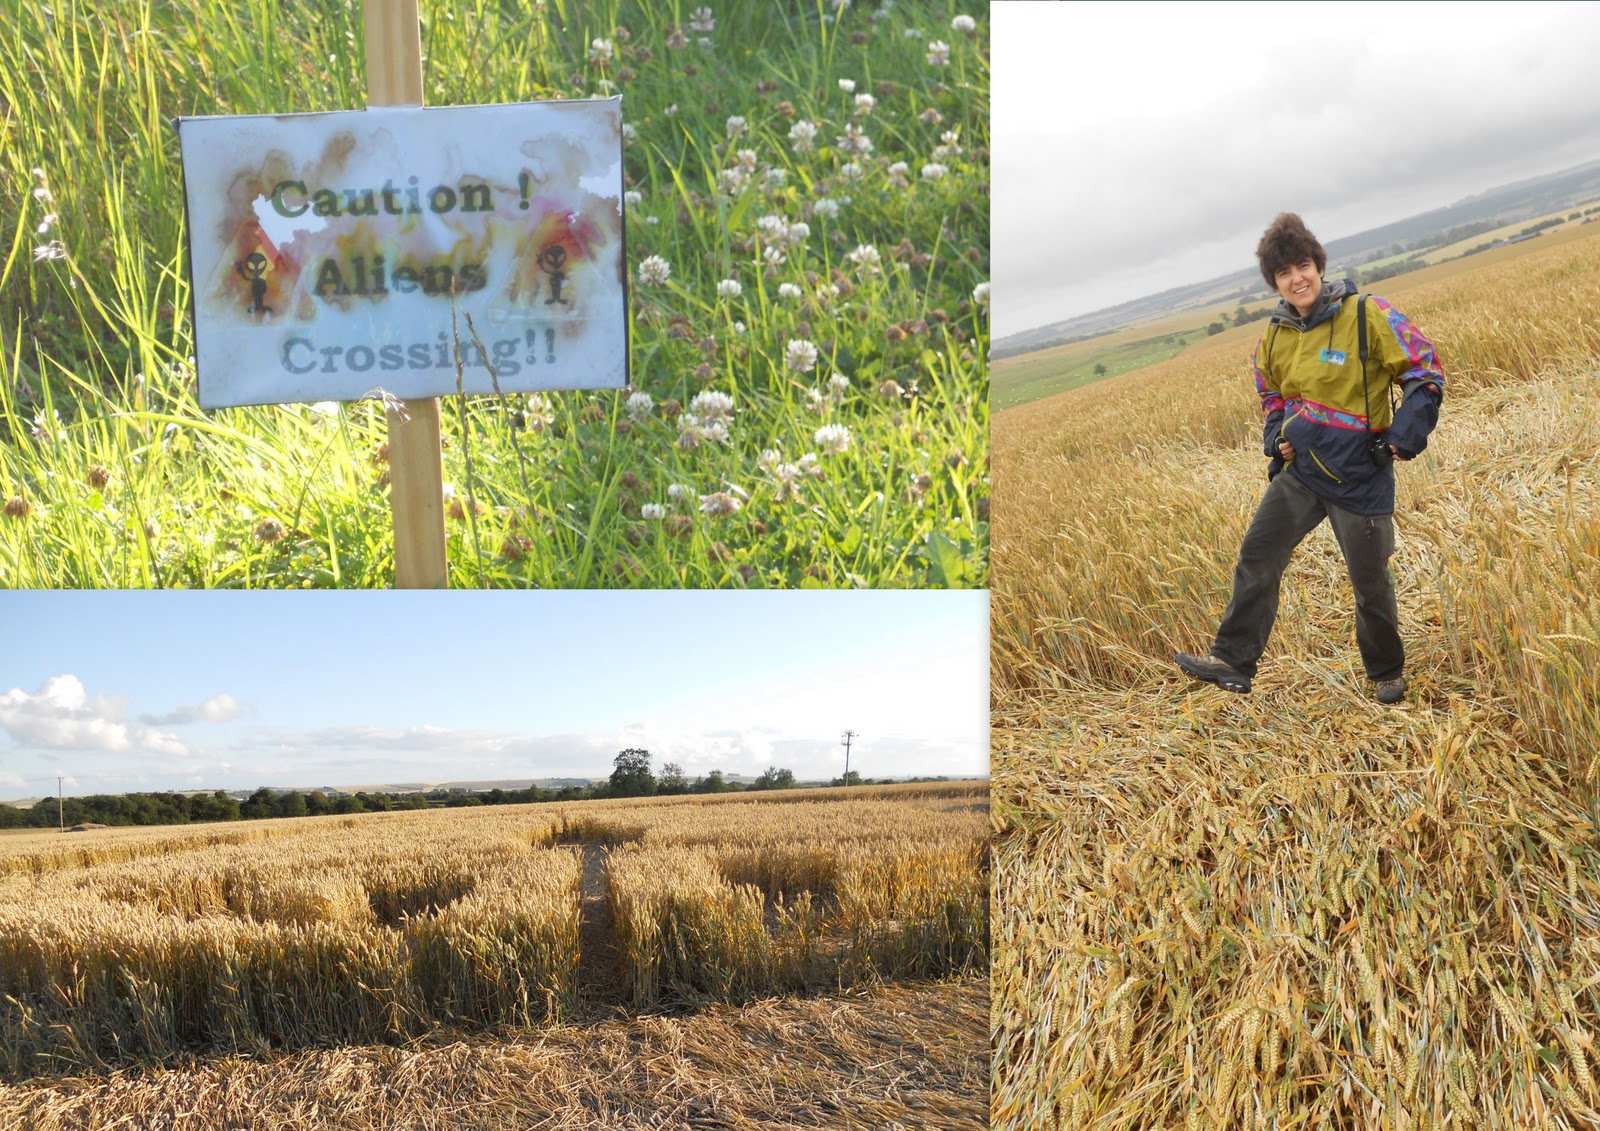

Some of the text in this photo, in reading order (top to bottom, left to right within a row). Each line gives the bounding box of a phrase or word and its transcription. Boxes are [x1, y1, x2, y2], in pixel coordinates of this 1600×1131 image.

[270, 172, 531, 218] Caution !
[313, 254, 487, 297] Aliens
[282, 328, 557, 377] Crossing!!
